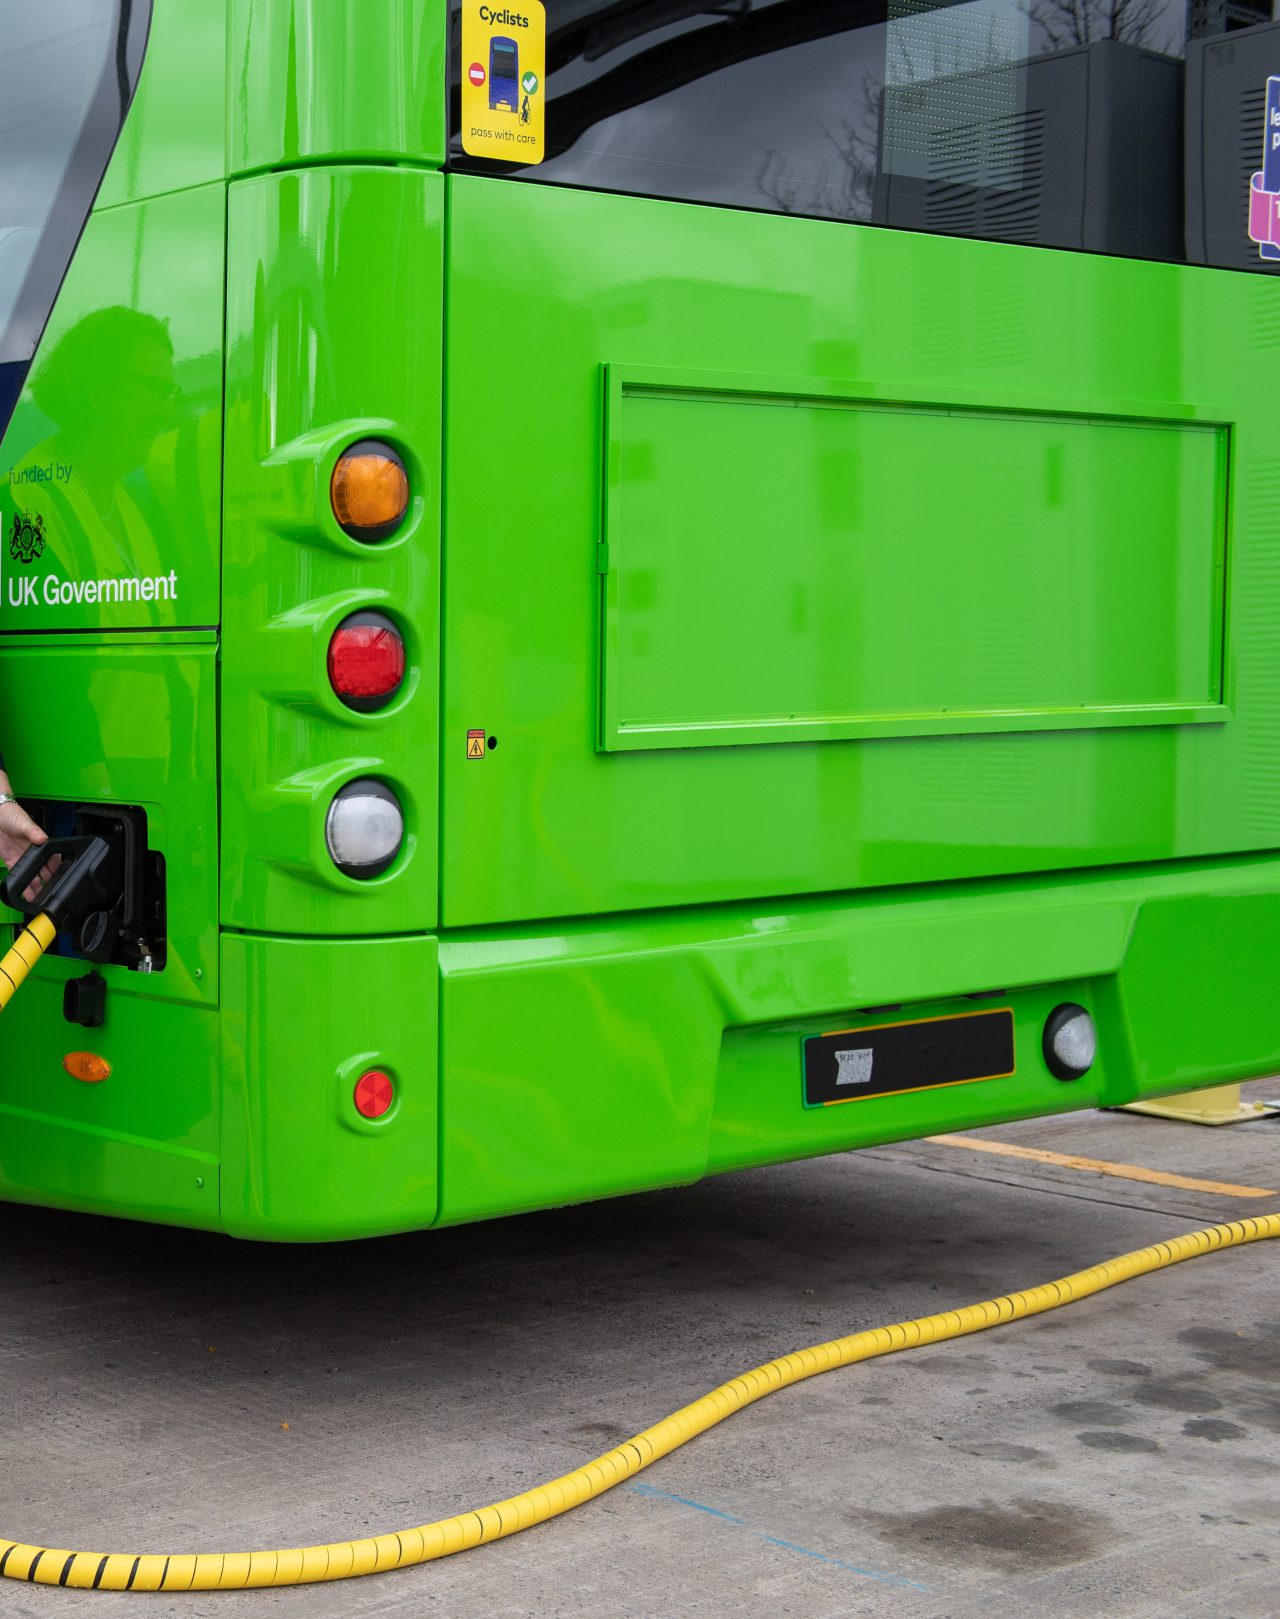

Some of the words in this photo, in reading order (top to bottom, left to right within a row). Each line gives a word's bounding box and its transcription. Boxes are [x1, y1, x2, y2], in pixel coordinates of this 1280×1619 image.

[479, 5, 529, 28] Cyclists
[471, 126, 493, 138] pass
[494, 129, 515, 142] with
[517, 133, 537, 145] care
[9, 463, 53, 485] funded
[56, 461, 73, 484] by
[8, 576, 39, 607] UK
[43, 569, 178, 606] Government
